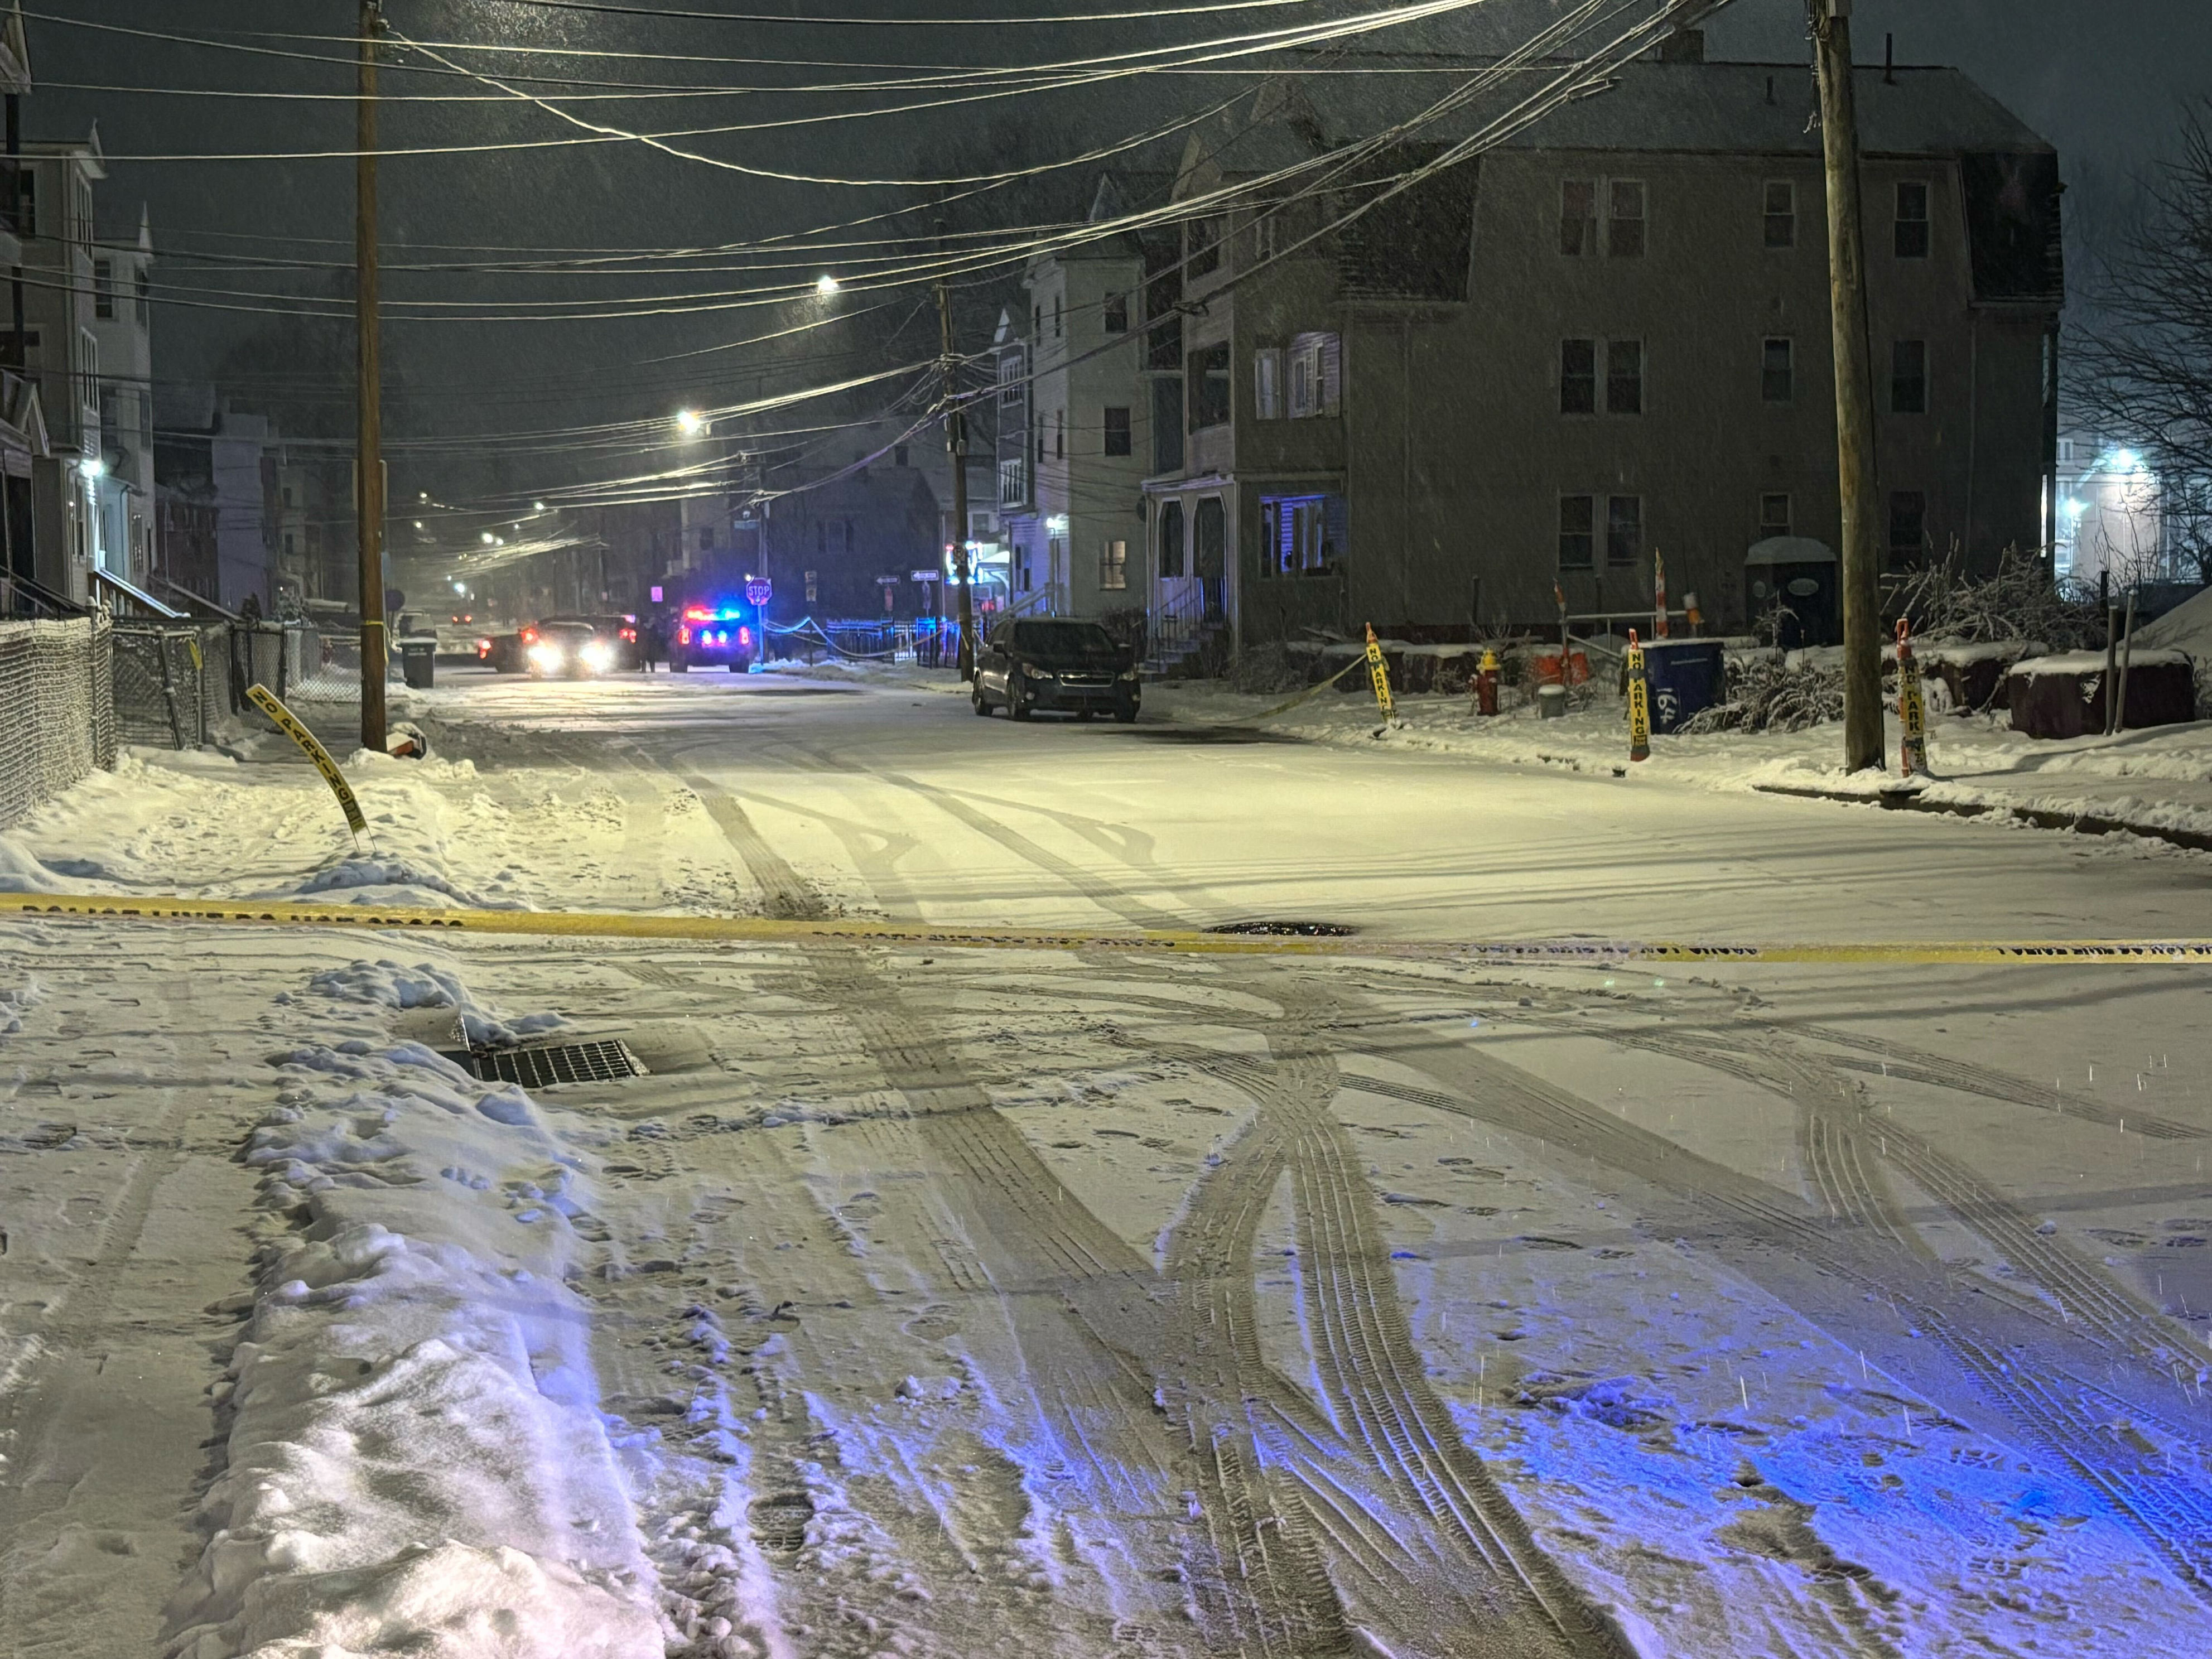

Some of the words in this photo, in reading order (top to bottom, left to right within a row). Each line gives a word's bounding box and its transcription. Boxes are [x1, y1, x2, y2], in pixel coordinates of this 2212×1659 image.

[748, 586, 770, 596] STOP
[1369, 648, 1379, 662] NO
[1632, 653, 1641, 670] NO
[1633, 677, 1645, 735] ARKING
[1656, 687, 1678, 725] 164
[253, 691, 278, 715] NO
[281, 717, 350, 801] PARKING
